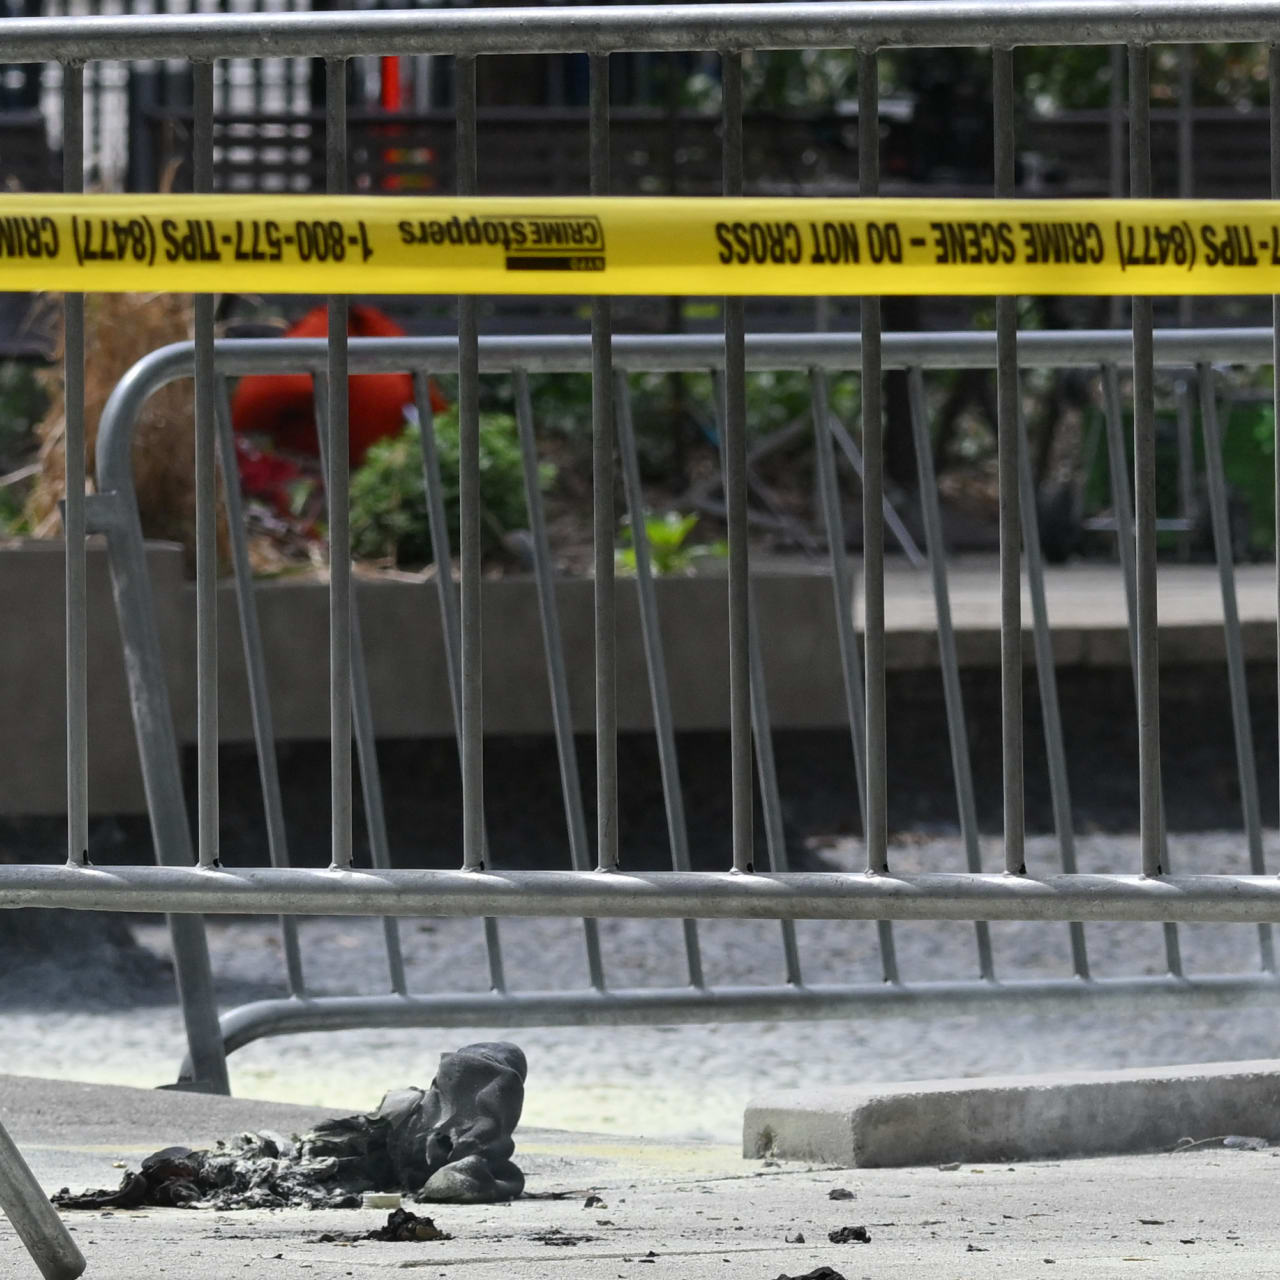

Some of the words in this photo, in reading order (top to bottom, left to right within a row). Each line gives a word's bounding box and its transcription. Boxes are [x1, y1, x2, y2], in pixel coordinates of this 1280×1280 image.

[72, 216, 157, 266] (8477)
[161, 220, 374, 263] 1-800-577-TIPS
[714, 222, 803, 264] CROSS
[809, 222, 860, 264] NOT
[866, 222, 904, 264] DO
[930, 222, 1016, 264] SCENE
[1019, 222, 1105, 264] CRIME
[1116, 221, 1197, 270] (8477)
